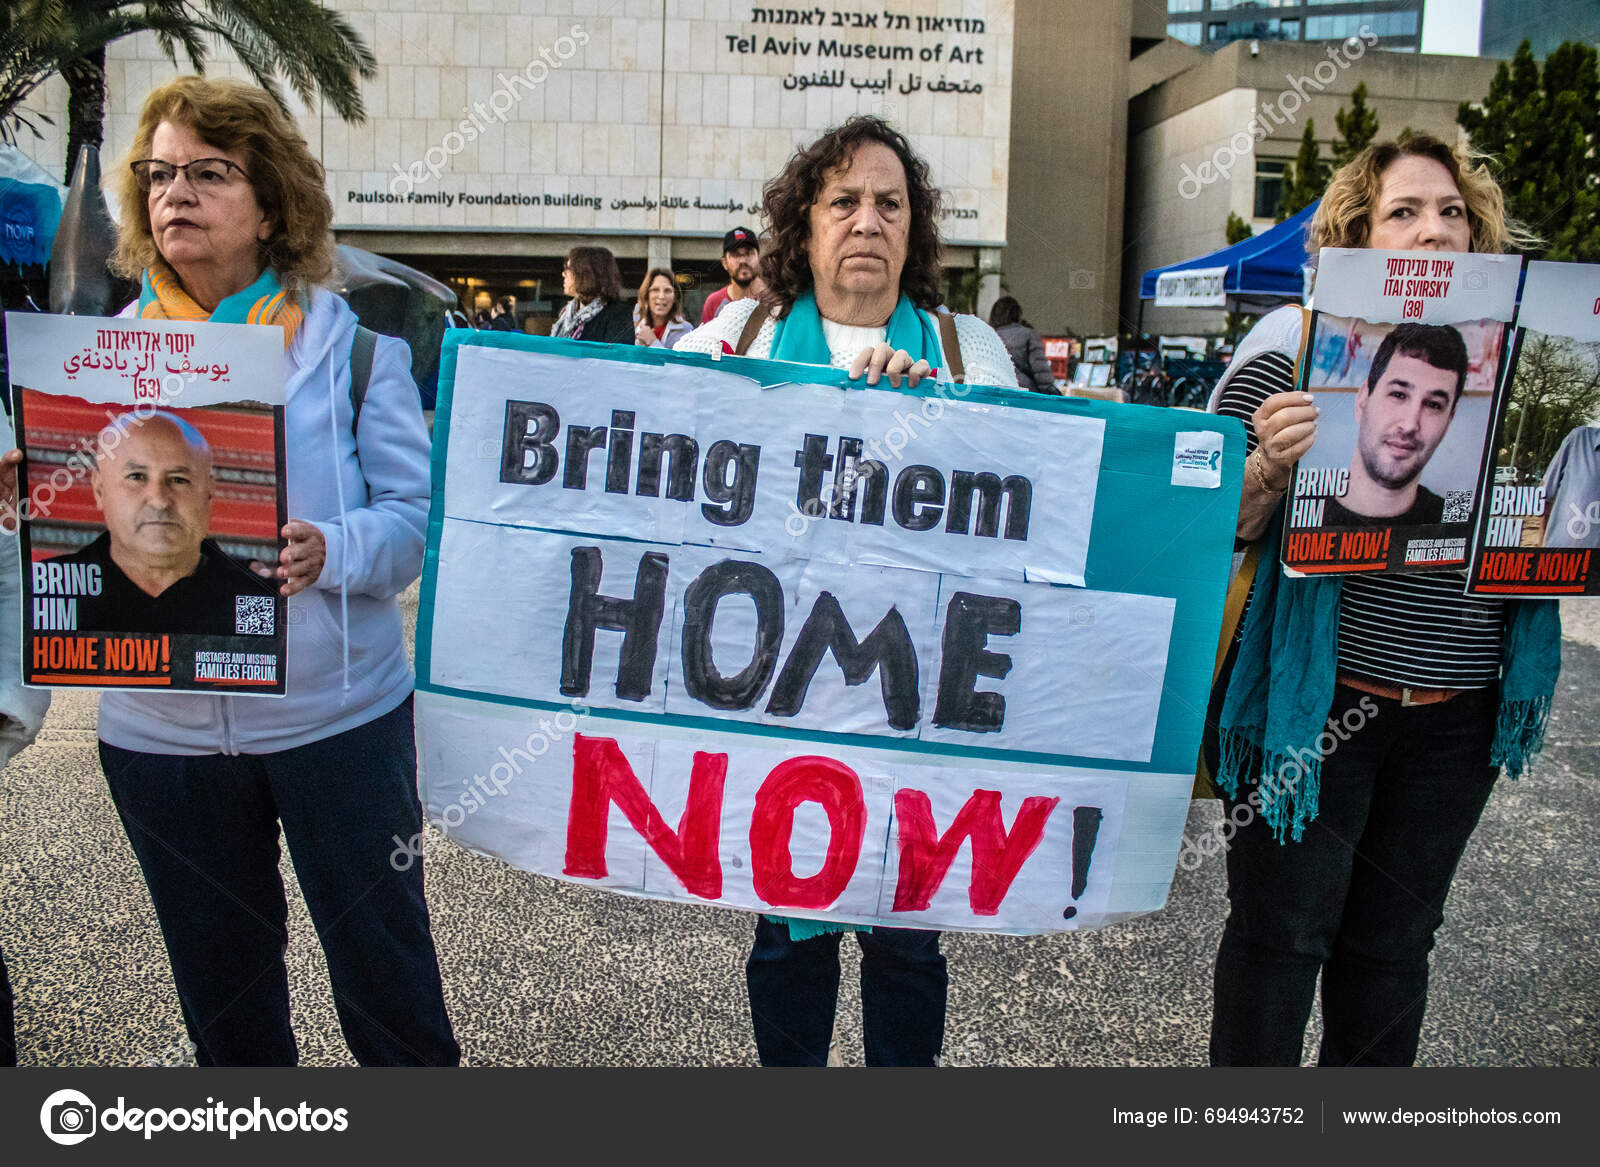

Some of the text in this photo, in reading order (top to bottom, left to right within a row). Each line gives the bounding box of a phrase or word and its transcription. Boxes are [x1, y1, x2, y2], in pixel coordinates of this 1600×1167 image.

[751, 8, 985, 34] מוזיאון תל אביב לאמנות
[726, 35, 983, 64] Tel Aviv Museum of Art
[783, 69, 983, 95] متحف تل أبيب للفنون
[348, 191, 602, 210] Paulson Family Foundation Building
[611, 196, 657, 211] بولسون
[694, 196, 743, 213] مؤسسة
[1387, 258, 1455, 278] איתי סבירסקי
[1383, 279, 1450, 298] ITAI SVIRSKY
[1402, 299, 1424, 319] (38)
[97, 329, 194, 355] יוסף אלזיאדנה
[165, 354, 230, 382] يوسف
[134, 377, 161, 400] (53)
[499, 399, 762, 527] Bring
[795, 432, 1033, 541] them
[1295, 468, 1350, 497] BRING
[1290, 499, 1325, 528] HIM
[1491, 486, 1546, 516] BRING
[1287, 528, 1391, 562] HOME NOW!
[1485, 518, 1524, 548] HIM
[1405, 547, 1465, 562] FAMILIES FORUM
[1479, 550, 1590, 582] HOME NOW!
[32, 562, 102, 596] BRING
[32, 597, 77, 631] HIM
[559, 546, 1022, 733] HOME
[33, 635, 171, 673] HOME NOW!
[195, 651, 277, 666] HOSTAGES AND MISSING
[195, 663, 276, 681] FAMILIES FORUM
